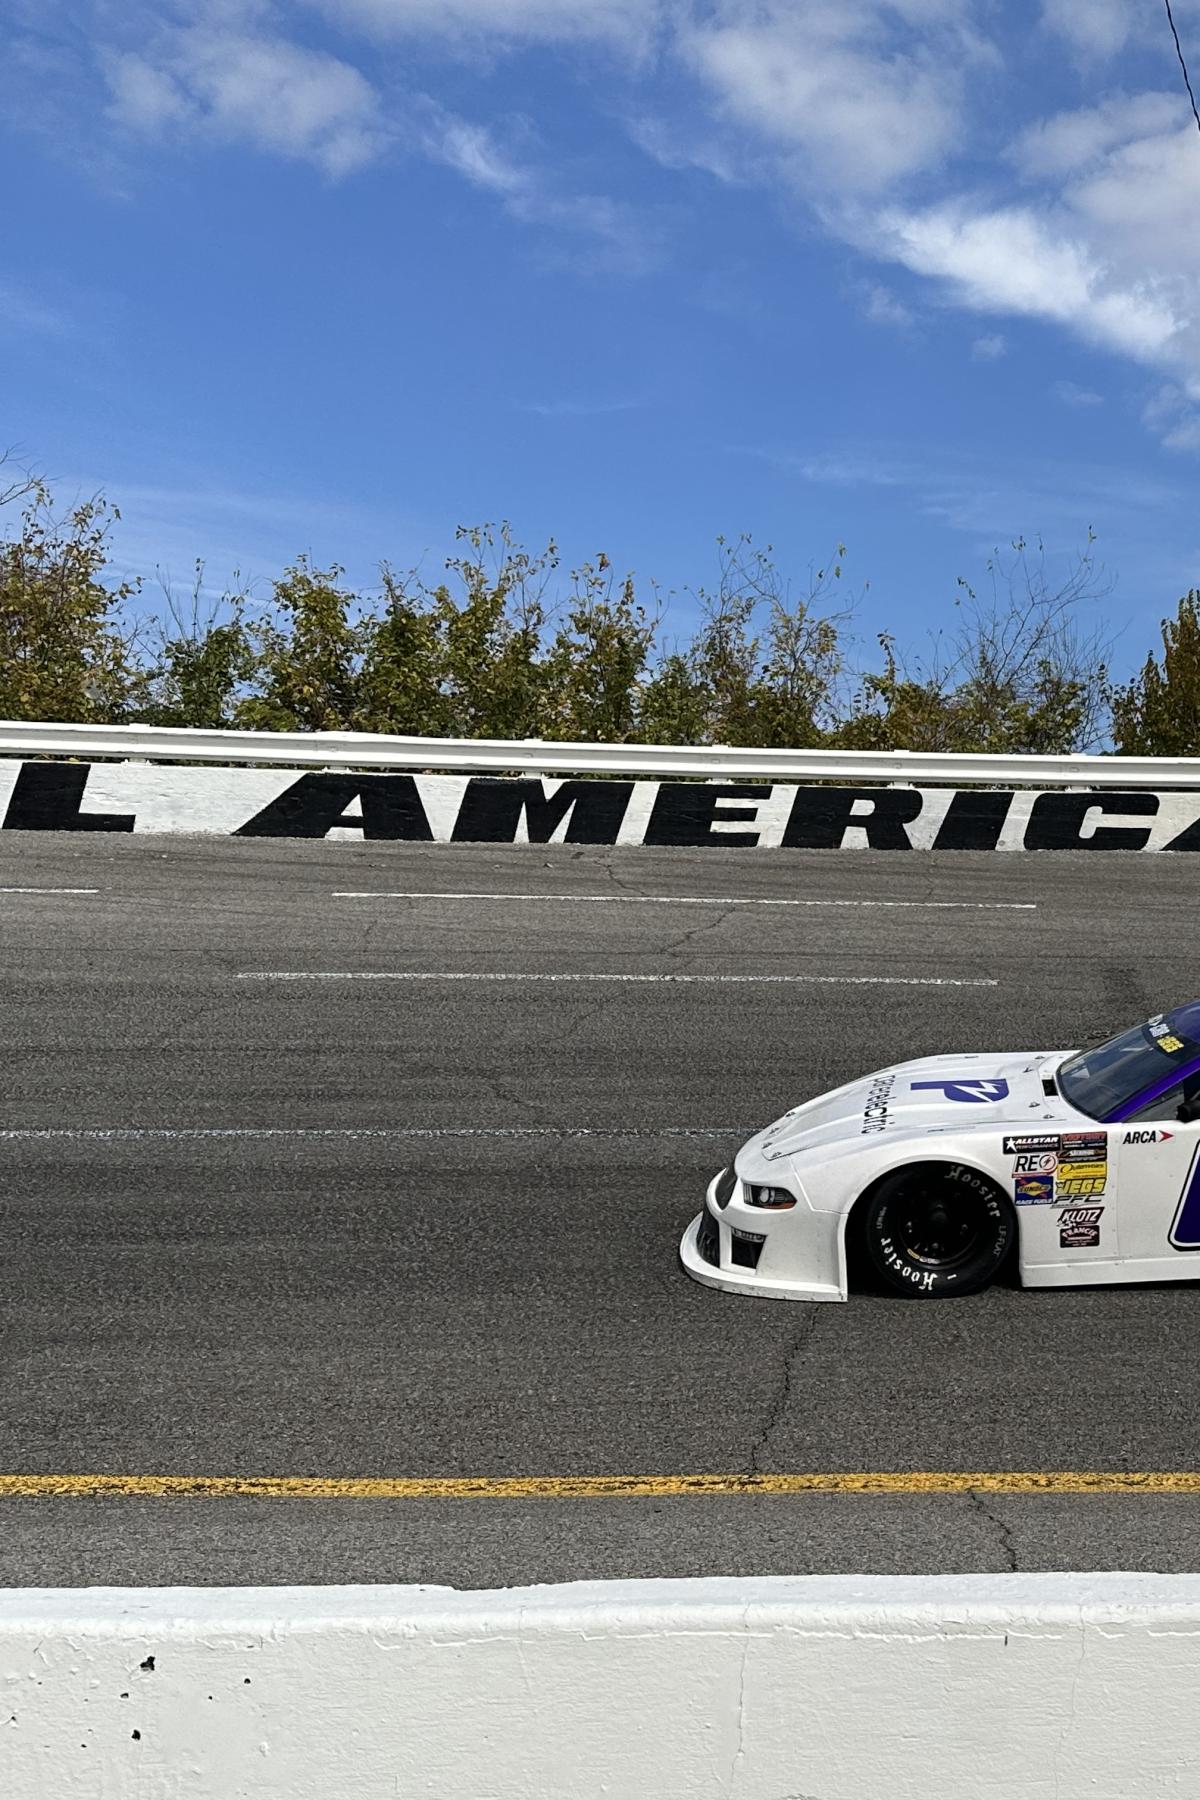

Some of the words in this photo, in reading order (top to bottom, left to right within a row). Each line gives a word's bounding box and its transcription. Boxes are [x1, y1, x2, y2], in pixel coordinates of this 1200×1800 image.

[3, 762, 137, 832] L
[1015, 1136, 1059, 1145] ALLSTAR
[1123, 1130, 1157, 1145] ARCA
[944, 1165, 1001, 1217] Hoosier
[1060, 1178, 1106, 1195] JEGS
[1061, 1209, 1101, 1222] KLOTZ
[880, 1237, 938, 1291] Hoosier
